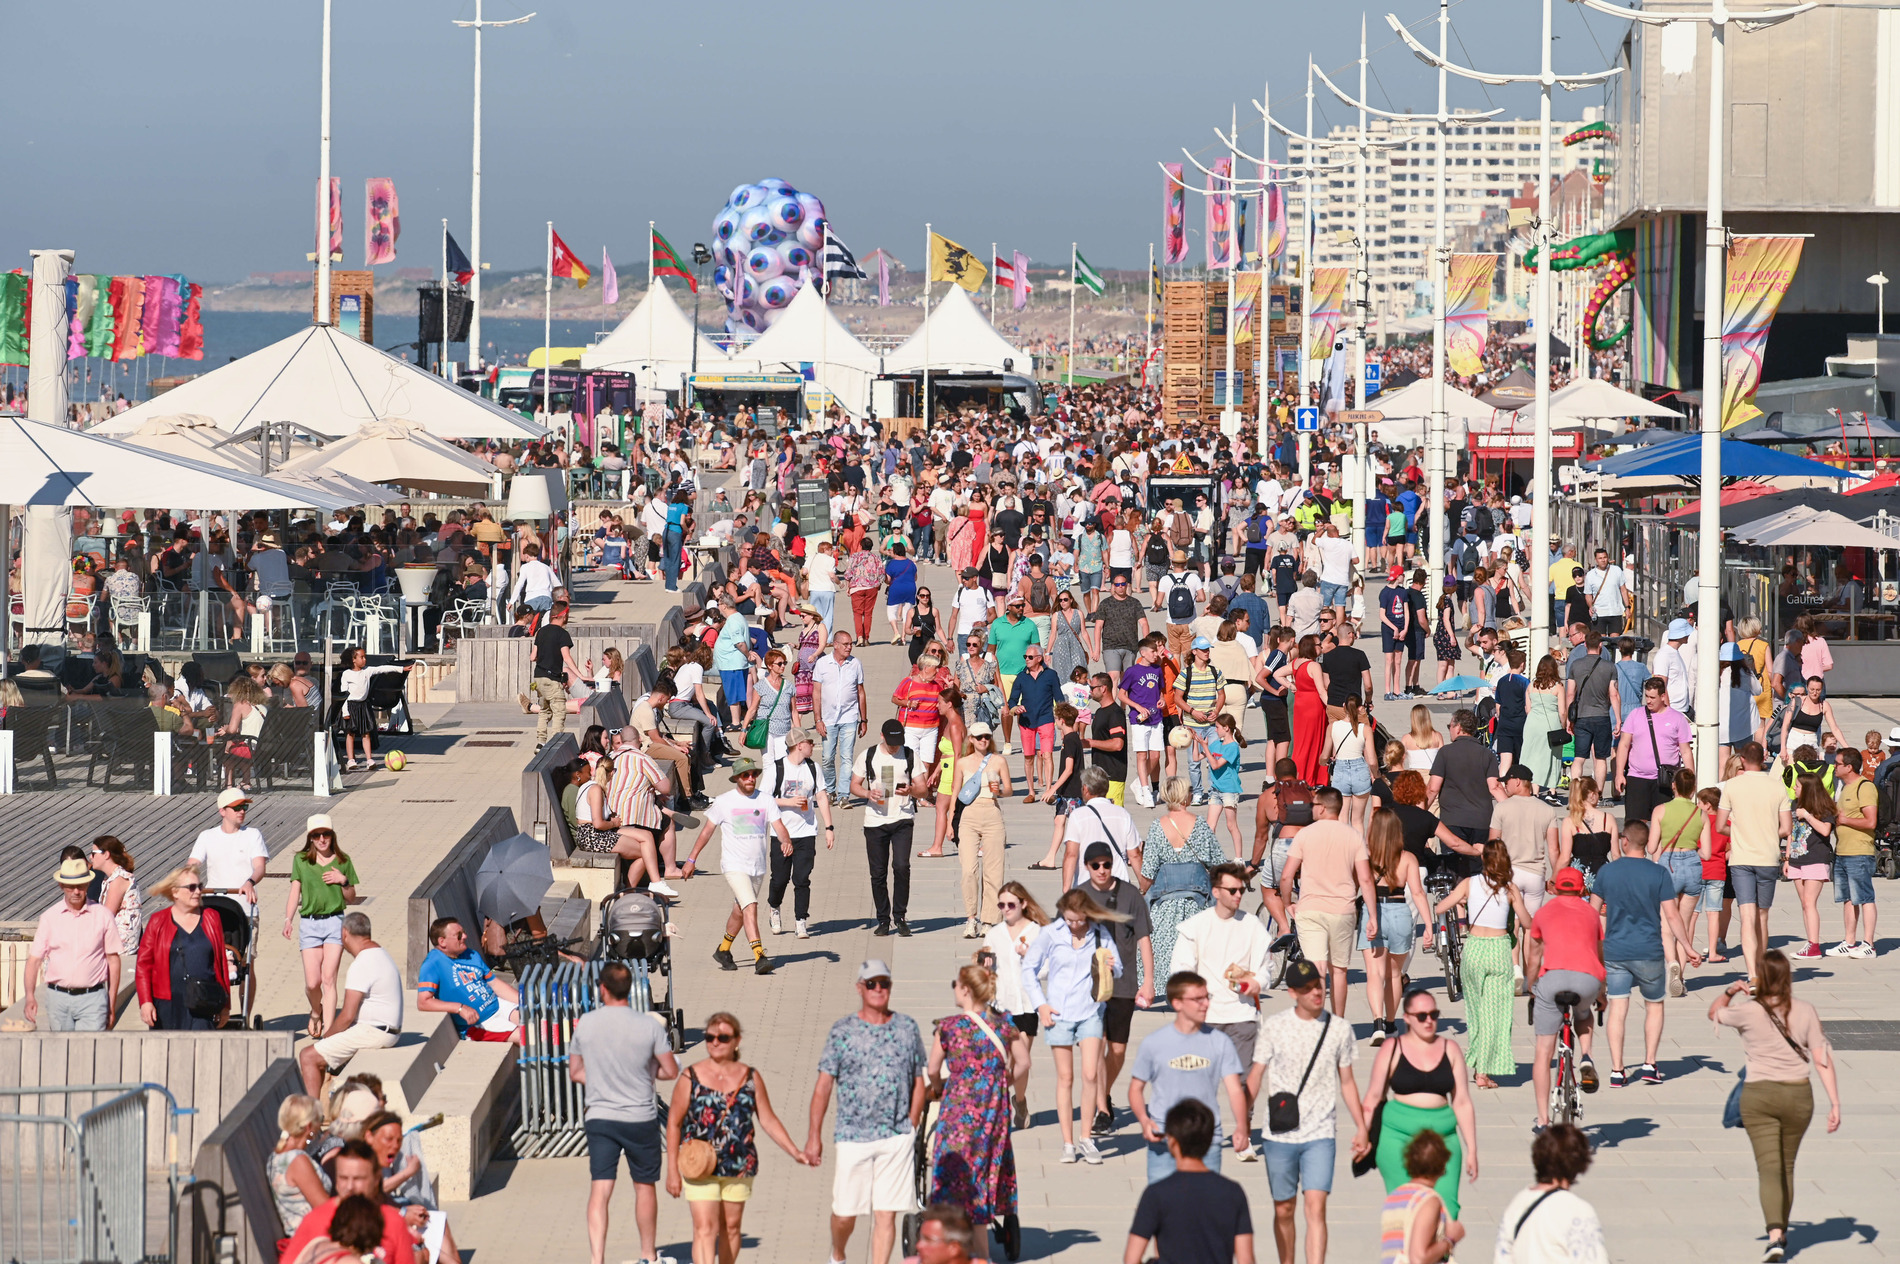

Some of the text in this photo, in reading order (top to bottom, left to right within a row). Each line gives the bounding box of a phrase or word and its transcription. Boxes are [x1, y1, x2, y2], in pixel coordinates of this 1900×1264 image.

[1732, 270, 1746, 281] LA
[1728, 282, 1790, 294] AVNTRE
[1505, 437, 1535, 445] CAISS
[1786, 594, 1825, 604] Gaufres
